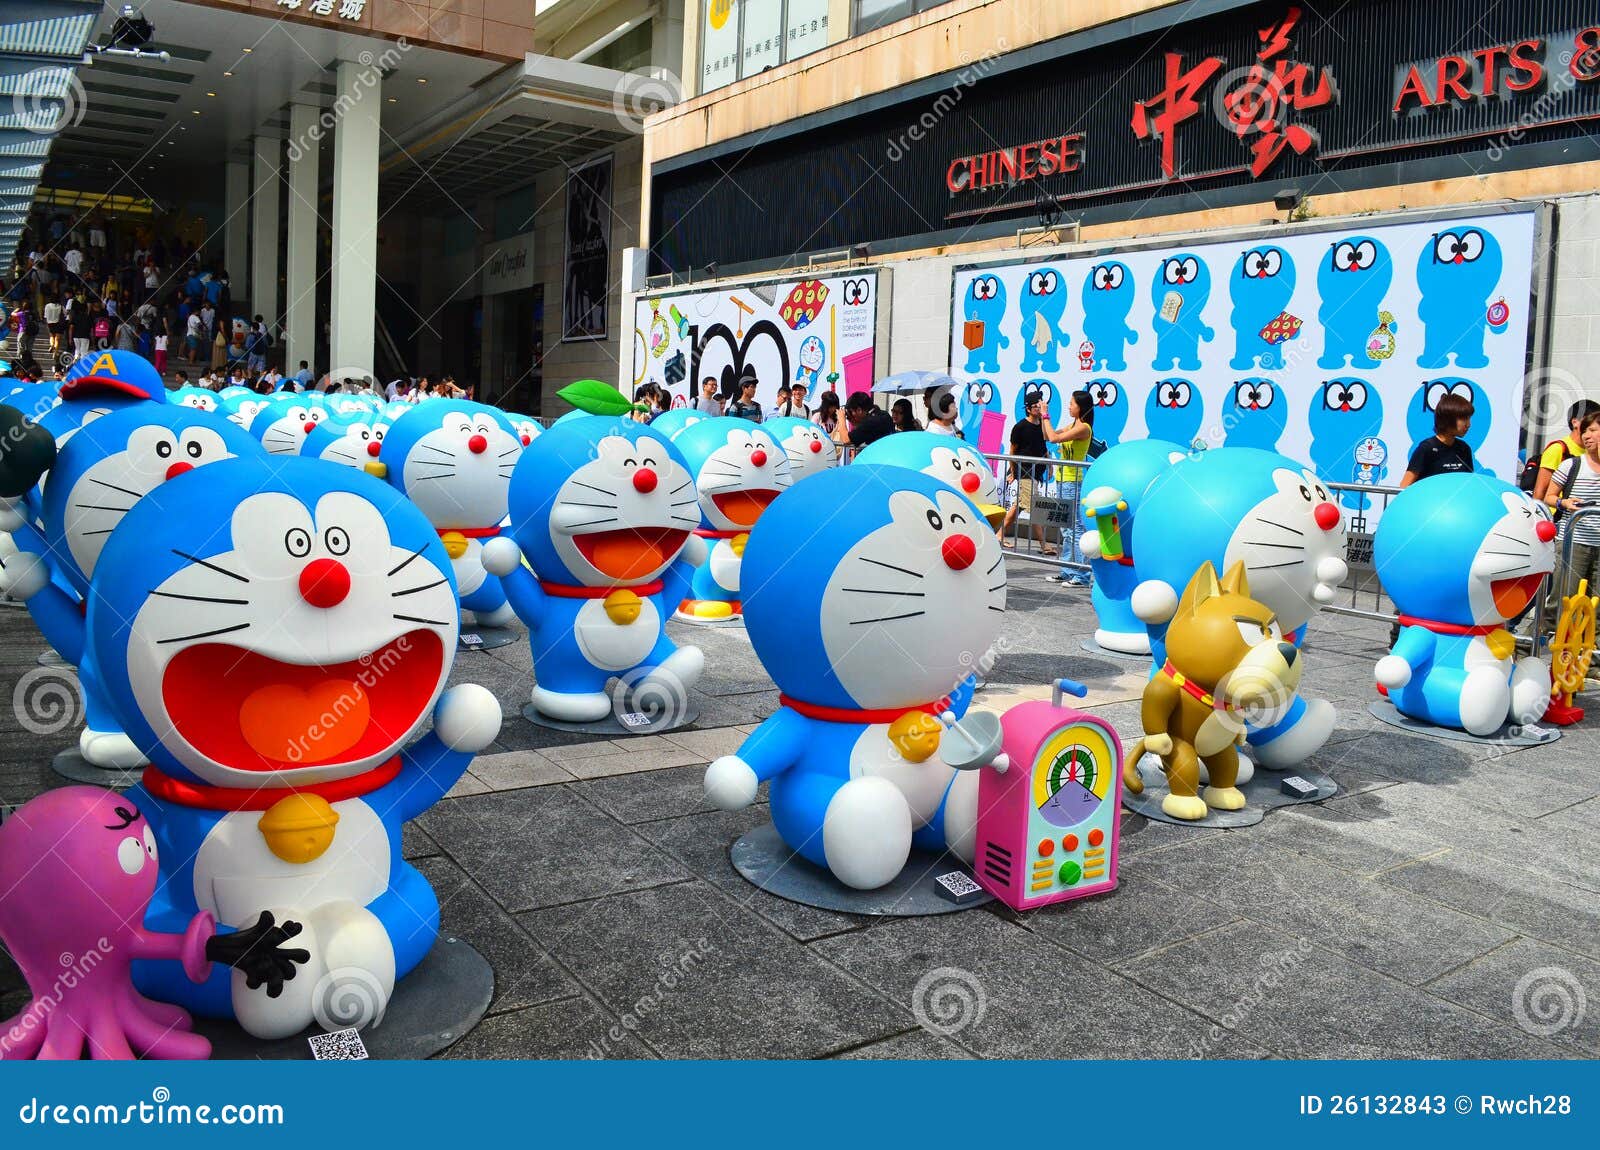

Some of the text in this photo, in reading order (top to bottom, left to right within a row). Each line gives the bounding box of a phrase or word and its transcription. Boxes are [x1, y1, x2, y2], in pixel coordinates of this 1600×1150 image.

[946, 133, 1080, 192] CHINESE
[1393, 39, 1543, 114] ARTS
[89, 353, 119, 375] A
[1355, 539, 1374, 549] CITY
